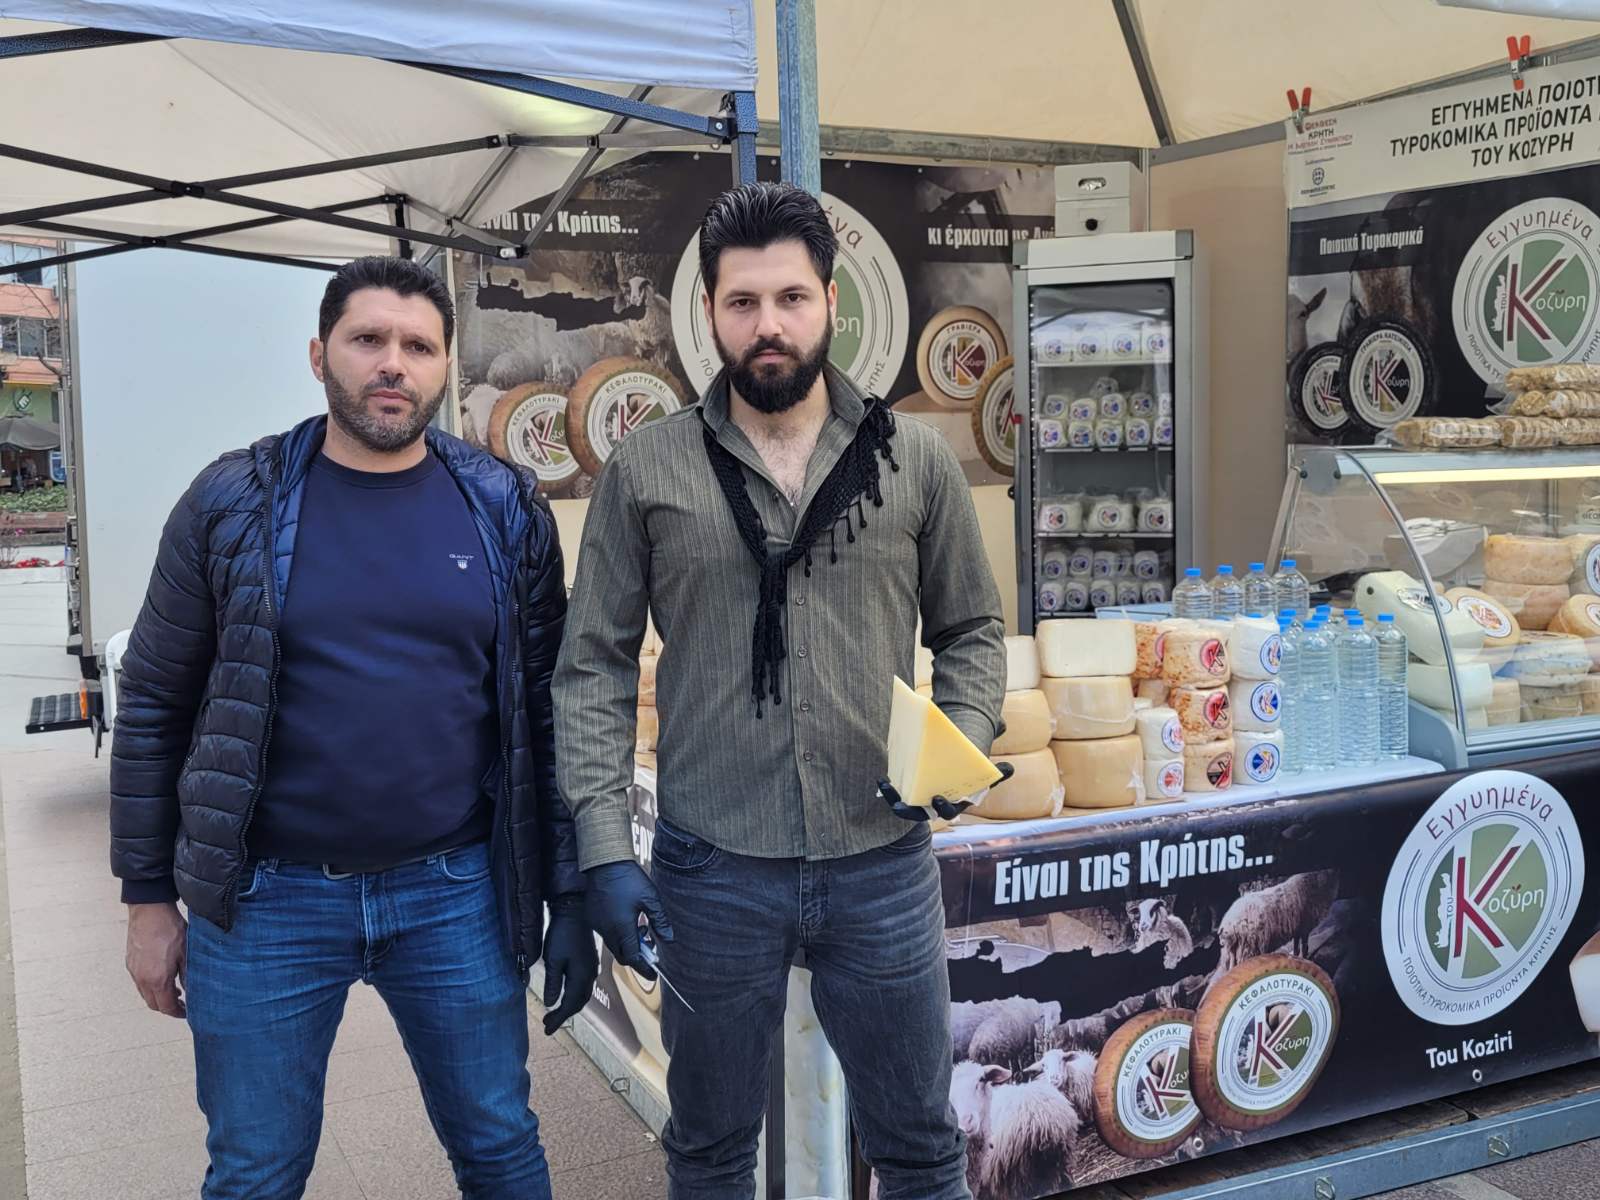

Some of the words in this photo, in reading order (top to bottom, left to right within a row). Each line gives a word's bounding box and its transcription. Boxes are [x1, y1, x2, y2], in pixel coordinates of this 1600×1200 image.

[1432, 89, 1533, 126] ΕΓΓΥΗΜΕΝΑ
[1390, 122, 1498, 157] ΤΥΡΟΚΟΜΙΚΑ
[1504, 104, 1592, 138] ΠΡΟΪΟΝΤΑ
[1472, 145, 1504, 167] ΤΟΥ
[1509, 132, 1574, 162] ΚΟΖΥΡΗ
[1486, 209, 1592, 249] Εγγυημένα
[1426, 784, 1553, 840] Εγγυημένα
[994, 857, 1070, 905] Είναι
[1079, 852, 1130, 892] της
[1238, 978, 1315, 1010] ΚΕΦΑΛΟΤΥΡΑΚΙ
[1425, 994, 1481, 1013] ΤΥΡΟΚΟΜΙΚΑ
[1123, 1027, 1182, 1078] ΚΕΦΑΛΟΤΥΡΑΚΙ
[1425, 1047, 1458, 1069] Tou
[1462, 1030, 1513, 1061] Koziri
